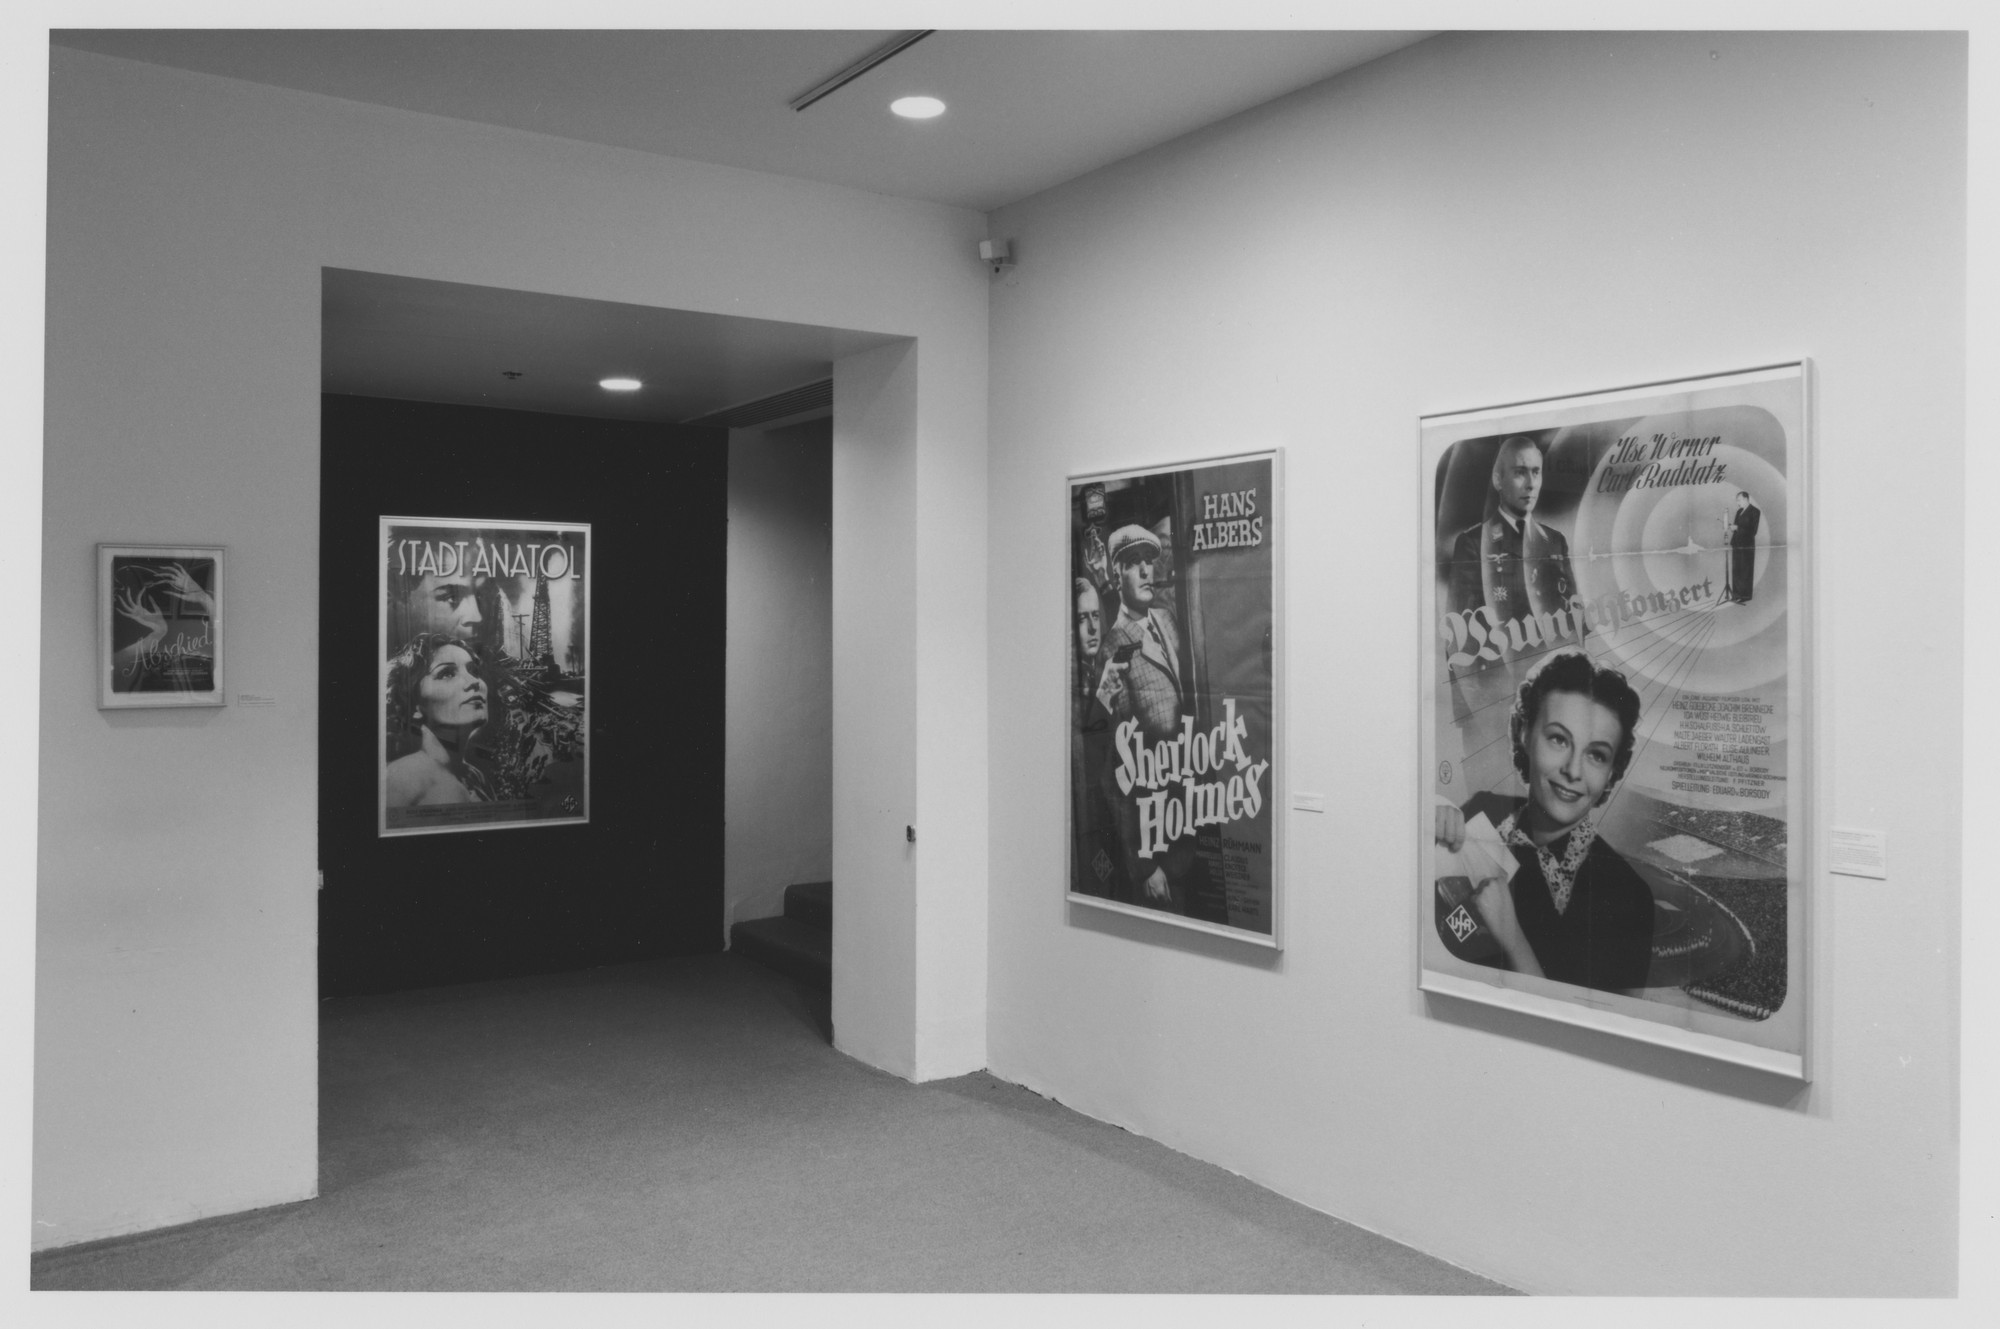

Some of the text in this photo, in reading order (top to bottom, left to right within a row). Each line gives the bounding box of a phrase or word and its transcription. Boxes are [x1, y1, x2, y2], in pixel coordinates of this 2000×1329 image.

[1608, 435, 1648, 465] Ilse
[1649, 432, 1722, 460] Werner
[1596, 464, 1641, 494] Carl
[1635, 457, 1728, 490] Raddatz
[1203, 487, 1257, 520] HANS
[1192, 515, 1263, 551] ALBERS
[398, 538, 581, 580] STADT ANATOL
[1114, 698, 1252, 797] Sherlock
[1135, 757, 1270, 860] Holmes
